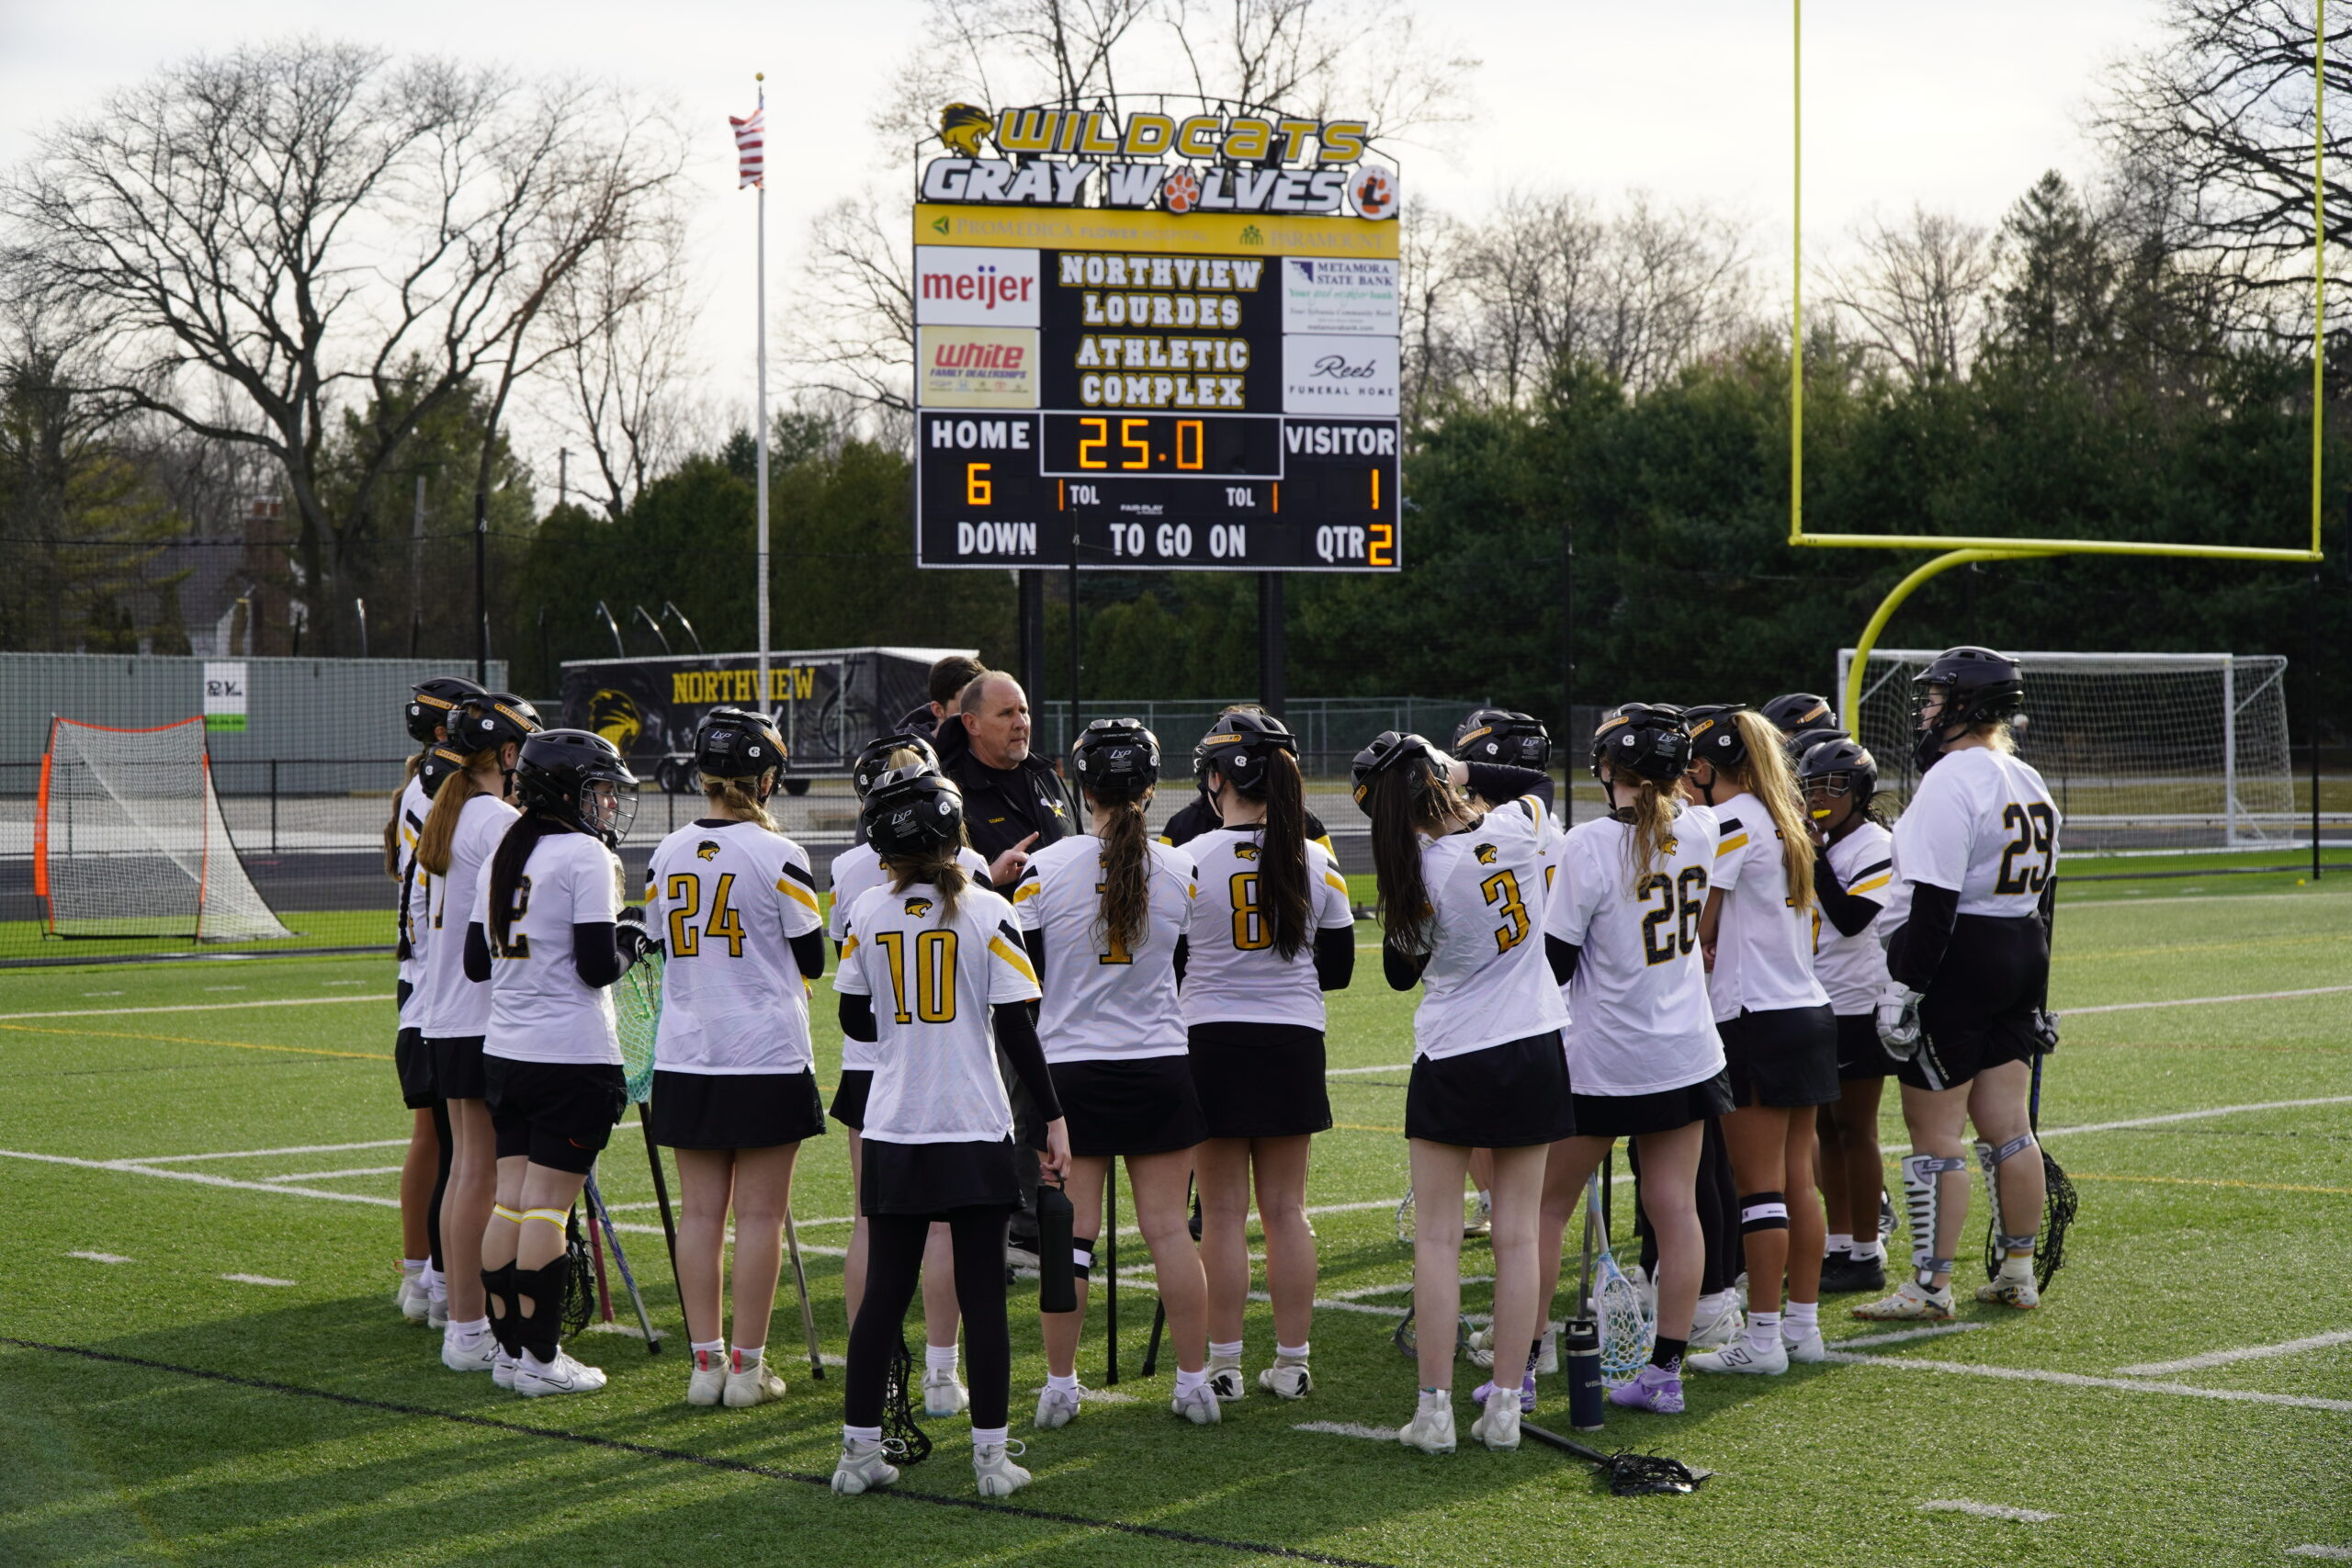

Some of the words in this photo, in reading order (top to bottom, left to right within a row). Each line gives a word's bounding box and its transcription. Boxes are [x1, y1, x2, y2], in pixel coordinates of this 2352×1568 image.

[922, 157, 1098, 203] GRAY
[1080, 227, 1137, 240] FLOWER
[1142, 229, 1208, 243] HOSPITAL
[1271, 230, 1386, 250] PARAMOUNT
[1058, 253, 1264, 291] NORTHVIEW
[1317, 262, 1389, 274] METAMORA
[1317, 275, 1352, 285] STATE
[1359, 276, 1393, 286] BANK
[922, 265, 1033, 309] meijer
[1083, 292, 1242, 329] LOURDES
[935, 343, 1024, 368] white
[1076, 334, 1250, 371] ATHLETIC
[1309, 355, 1376, 378] Reeb
[930, 369, 963, 378] FAMILY
[966, 369, 1027, 378] DEALERSHIPS
[1080, 373, 1245, 409] COMPLEX
[1289, 386, 1350, 395] FUNERAL
[1359, 387, 1394, 397] HOME
[932, 420, 1030, 450] HOME
[1285, 426, 1396, 456] VISITOR
[967, 463, 991, 505] 6
[1069, 485, 1100, 504] TOL
[1226, 487, 1255, 506] TOL
[1371, 468, 1379, 510] 1
[957, 522, 1037, 556] DOWN
[1110, 523, 1145, 557] TO
[1156, 523, 1193, 557] GO
[1209, 524, 1246, 558] ON
[1317, 525, 1365, 562] QTR
[1368, 525, 1393, 566] 2
[1993, 802, 2055, 896] 29
[667, 873, 747, 958] 24
[1229, 872, 1275, 952] 8
[1480, 869, 1532, 955] 3
[1637, 864, 1708, 967] 26
[876, 929, 958, 1024] 10
